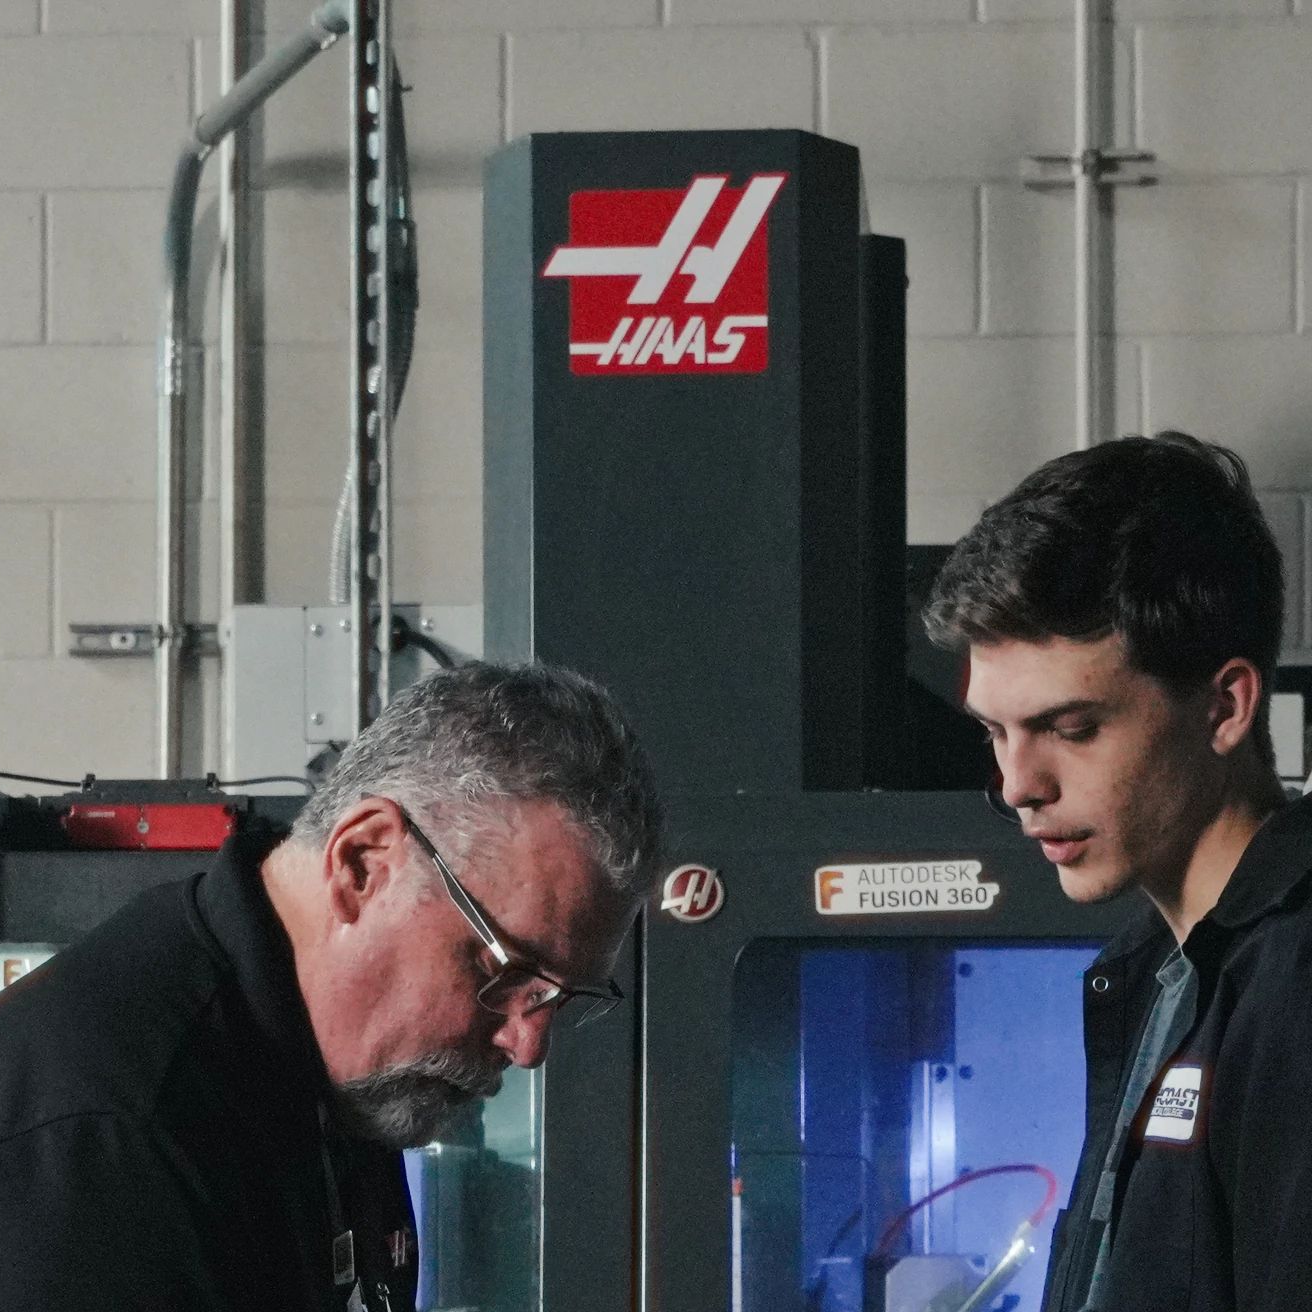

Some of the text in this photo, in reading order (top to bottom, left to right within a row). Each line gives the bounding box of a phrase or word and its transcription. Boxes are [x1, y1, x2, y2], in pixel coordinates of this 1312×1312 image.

[570, 315, 768, 365] HAAS
[858, 865, 973, 886] AUTODESK
[859, 888, 939, 909] FUSION
[947, 886, 988, 905] 360
